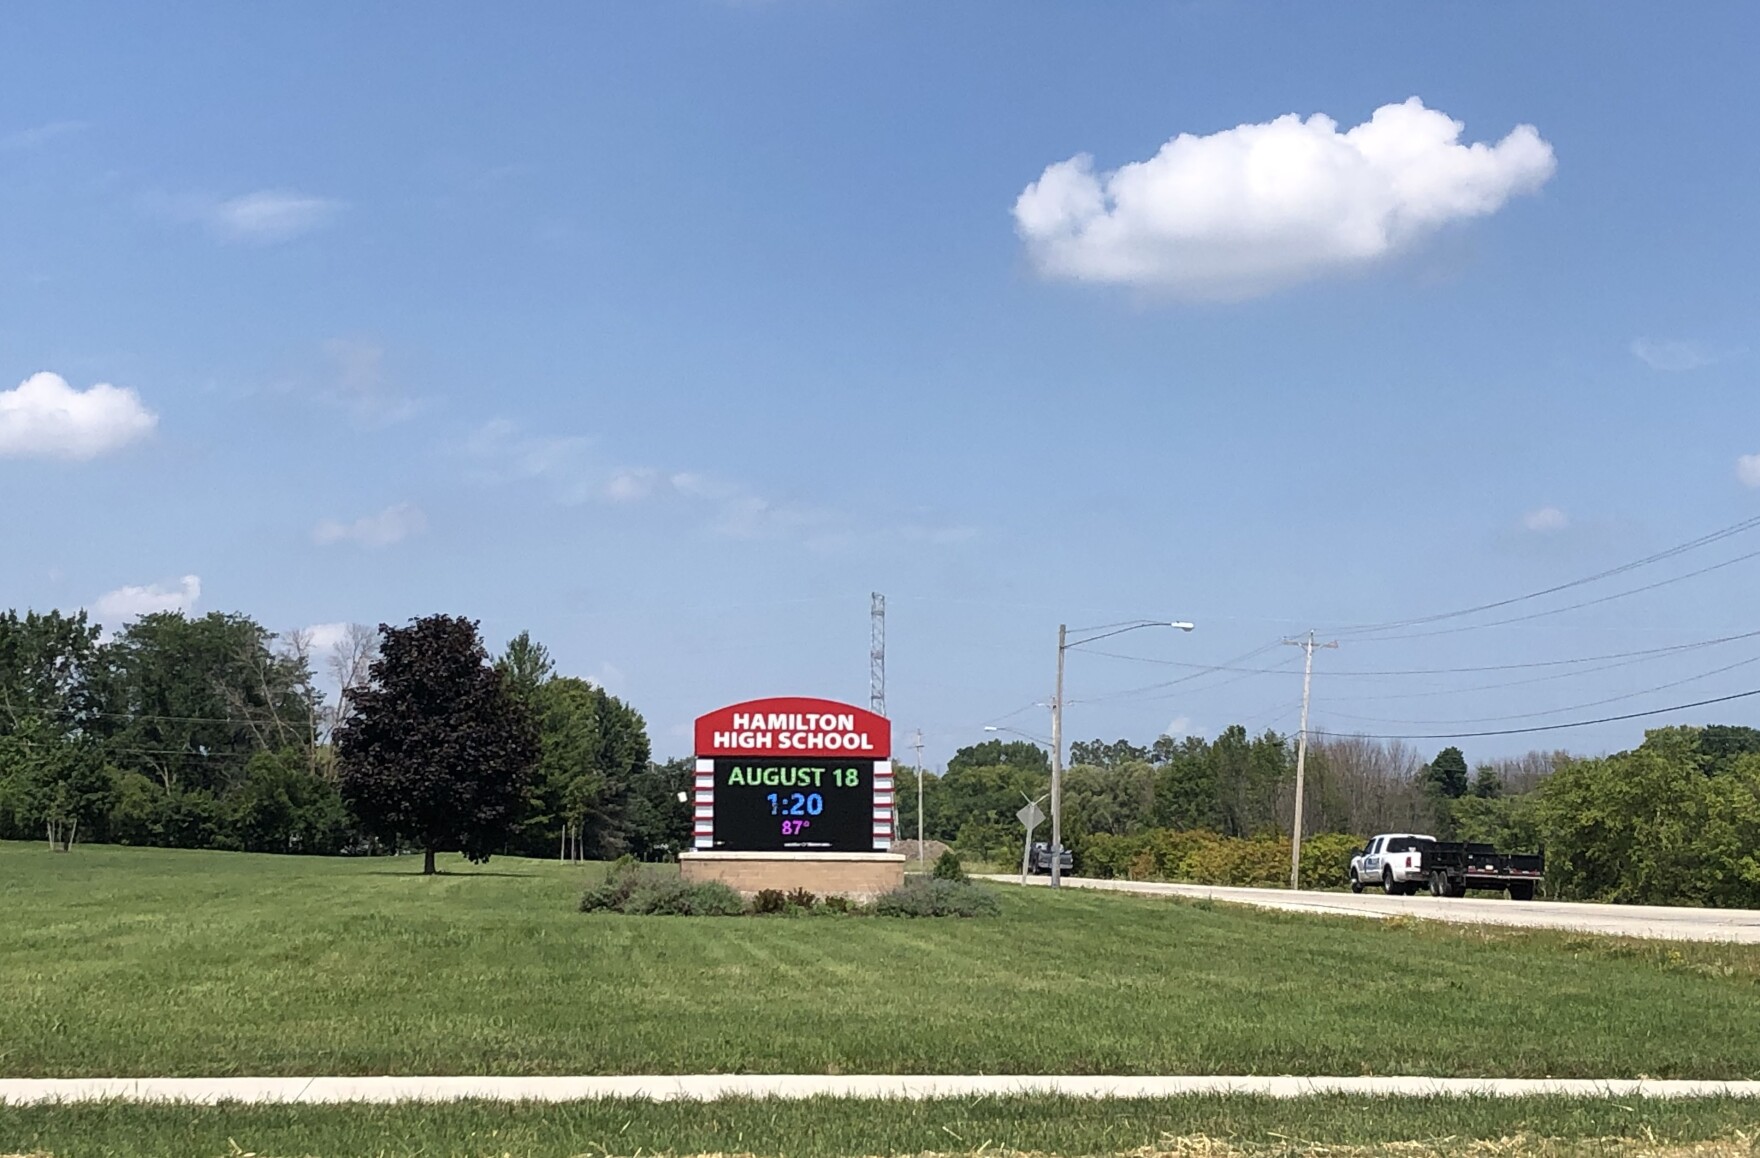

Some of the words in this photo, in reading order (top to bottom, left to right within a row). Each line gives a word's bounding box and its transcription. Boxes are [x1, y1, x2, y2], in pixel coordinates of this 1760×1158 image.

[733, 713, 854, 731] HAMILTON
[713, 732, 772, 748] HIGH
[778, 732, 873, 750] SCHOOL
[728, 766, 825, 787] AUGUST
[832, 768, 860, 787] 18
[767, 792, 823, 816] 1:20
